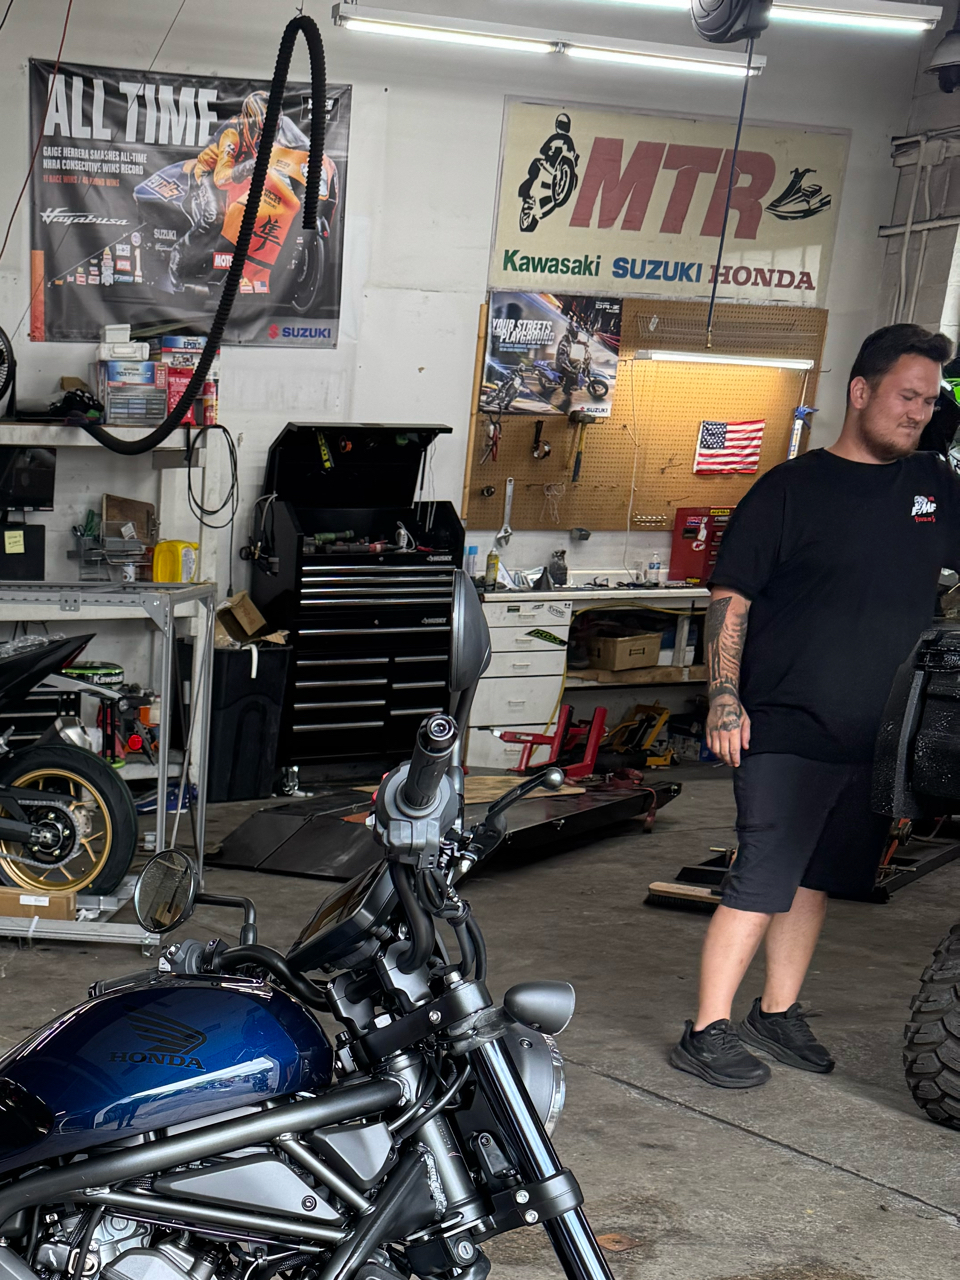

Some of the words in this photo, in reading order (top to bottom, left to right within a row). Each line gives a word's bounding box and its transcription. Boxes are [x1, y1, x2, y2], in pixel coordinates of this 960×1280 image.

[43, 73, 112, 141] ALL
[119, 81, 219, 147] TIME
[43, 146, 62, 157] GAIGE
[63, 147, 89, 159] HERRERA
[90, 149, 119, 161] SMASHES
[120, 152, 147, 163] ALL-TIME
[62, 160, 102, 173] CONSECUTIVE
[102, 163, 120, 174] WINS
[121, 164, 144, 175] RECORD
[568, 136, 776, 240] MTR
[40, 208, 131, 226] Hayabusa
[503, 249, 601, 277] Kawasaki
[612, 257, 702, 283] SUZUKI
[708, 264, 816, 291] HONDA
[282, 326, 331, 339] SUZUKI
[492, 319, 515, 332] YOUR
[516, 320, 553, 333] STREETS
[500, 331, 556, 345] PLAYGROUND
[108, 1051, 206, 1071] HONDA
